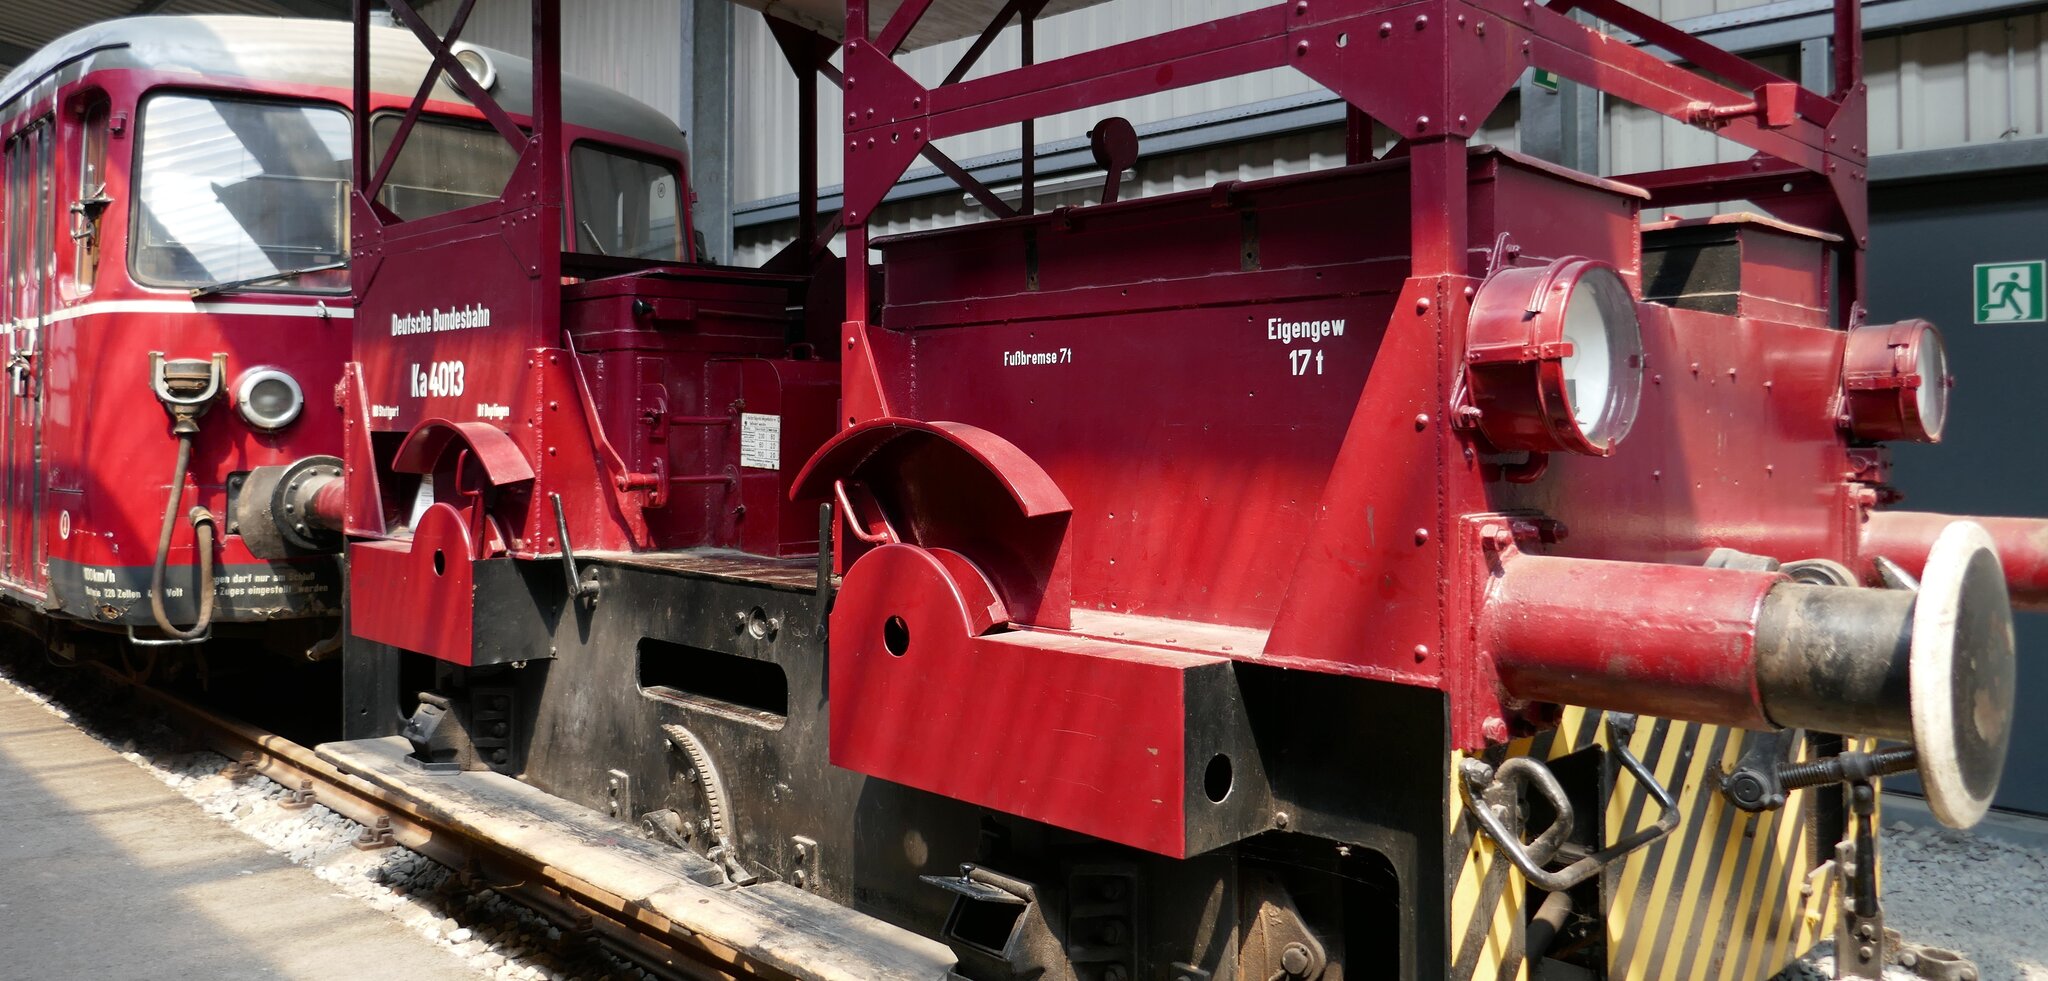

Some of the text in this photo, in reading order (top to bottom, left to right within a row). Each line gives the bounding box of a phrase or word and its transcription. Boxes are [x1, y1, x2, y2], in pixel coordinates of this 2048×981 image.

[391, 302, 490, 336] Deutsche Bundesbahn
[1267, 317, 1345, 345] Eigengew
[1004, 350, 1057, 366] Fußbremse
[1289, 349, 1312, 376] 17
[411, 360, 465, 398] Ka 4013
[232, 574, 252, 583] darf
[254, 575, 270, 583] nur
[272, 574, 286, 582] am
[116, 588, 142, 599] Zellen
[166, 588, 183, 597] Volt
[220, 587, 245, 598] Zuges
[247, 585, 292, 597] eingestellt
[298, 584, 328, 593] werden
